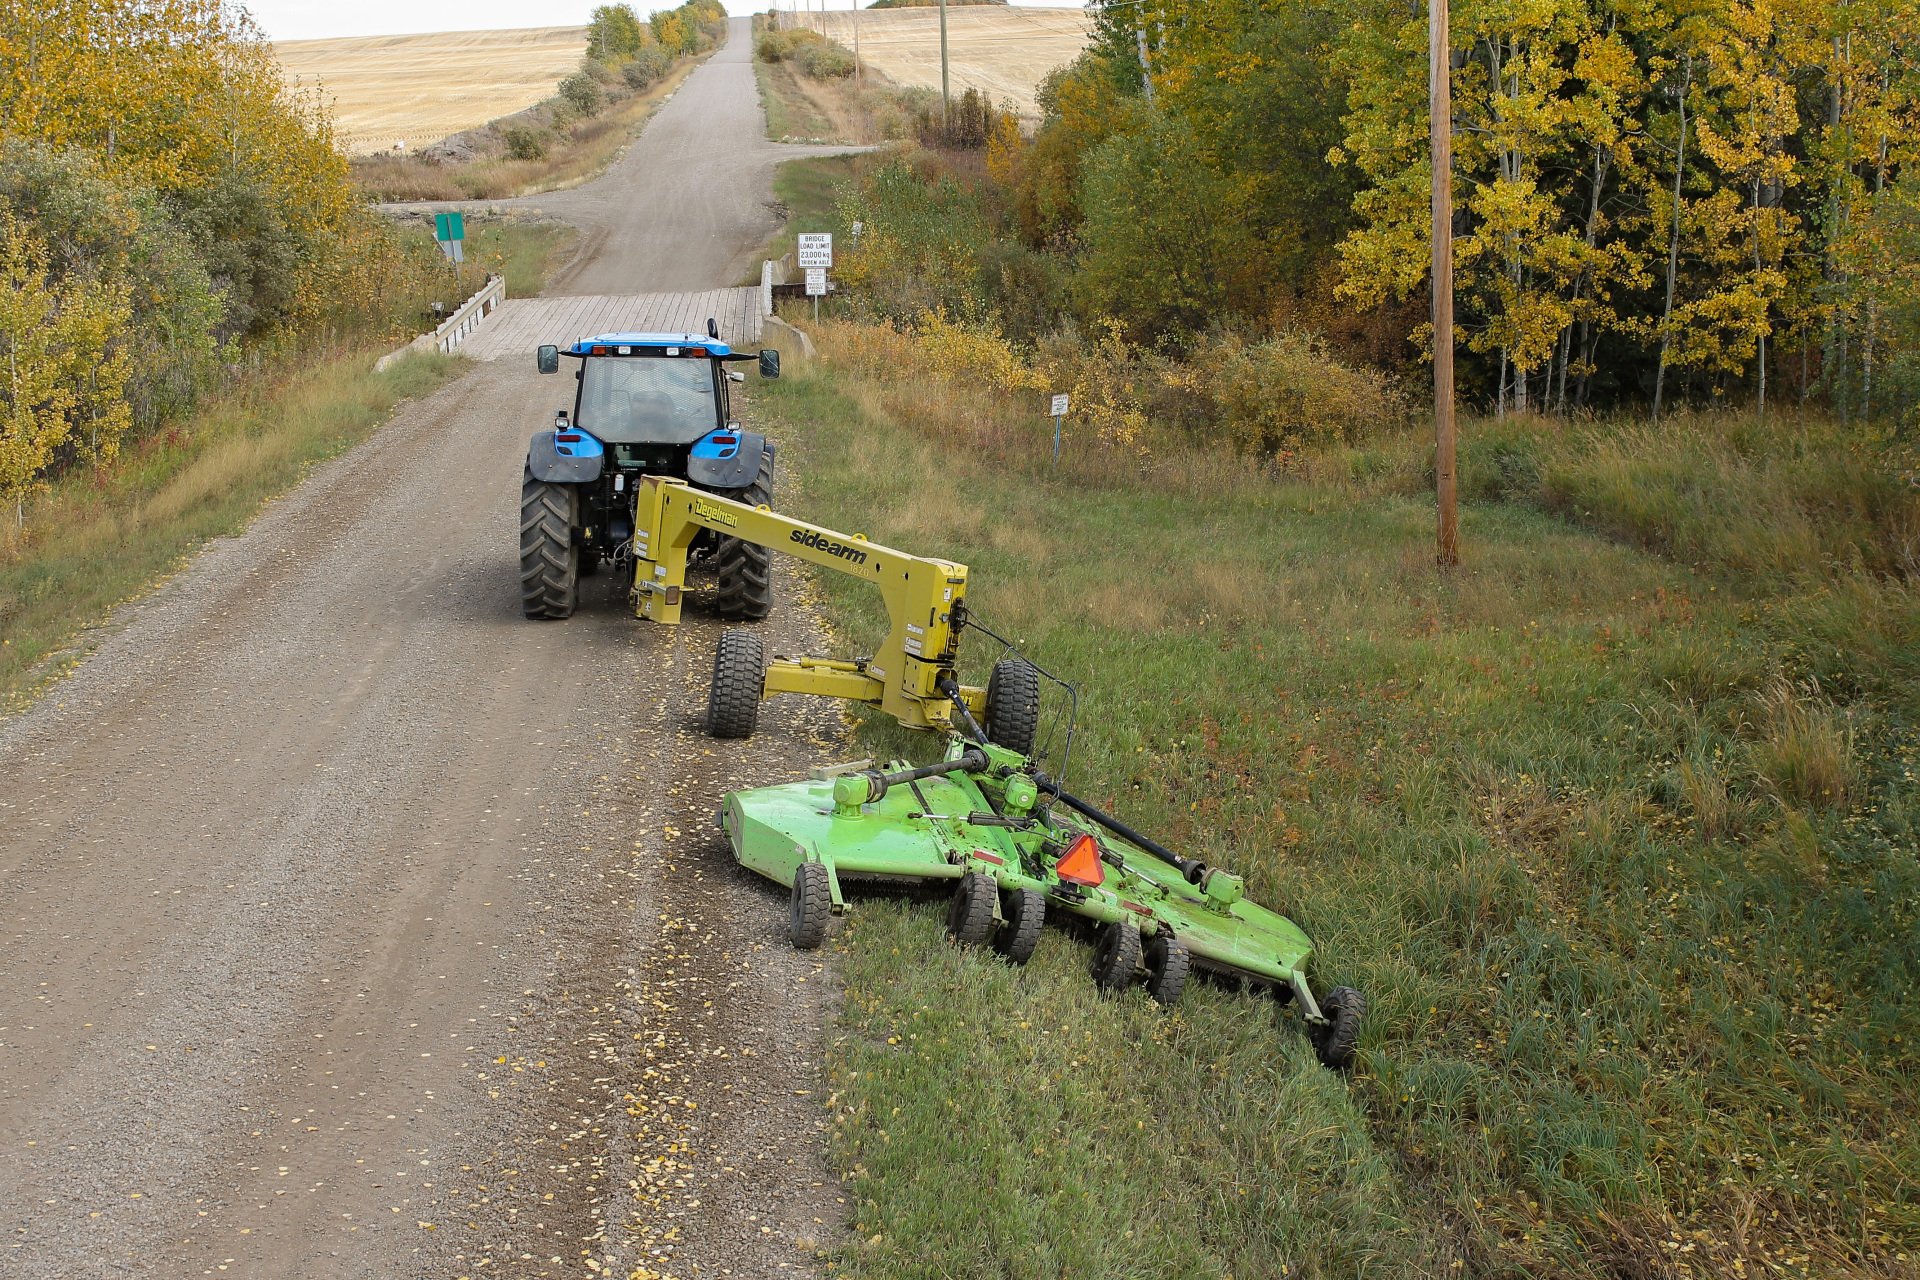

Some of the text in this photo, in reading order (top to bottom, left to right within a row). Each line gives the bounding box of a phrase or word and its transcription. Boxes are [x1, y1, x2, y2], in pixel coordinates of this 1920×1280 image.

[823, 252, 830, 260] kg
[695, 497, 738, 528] Degelman
[789, 529, 868, 565] sidearm
[849, 563, 870, 578] 1820
